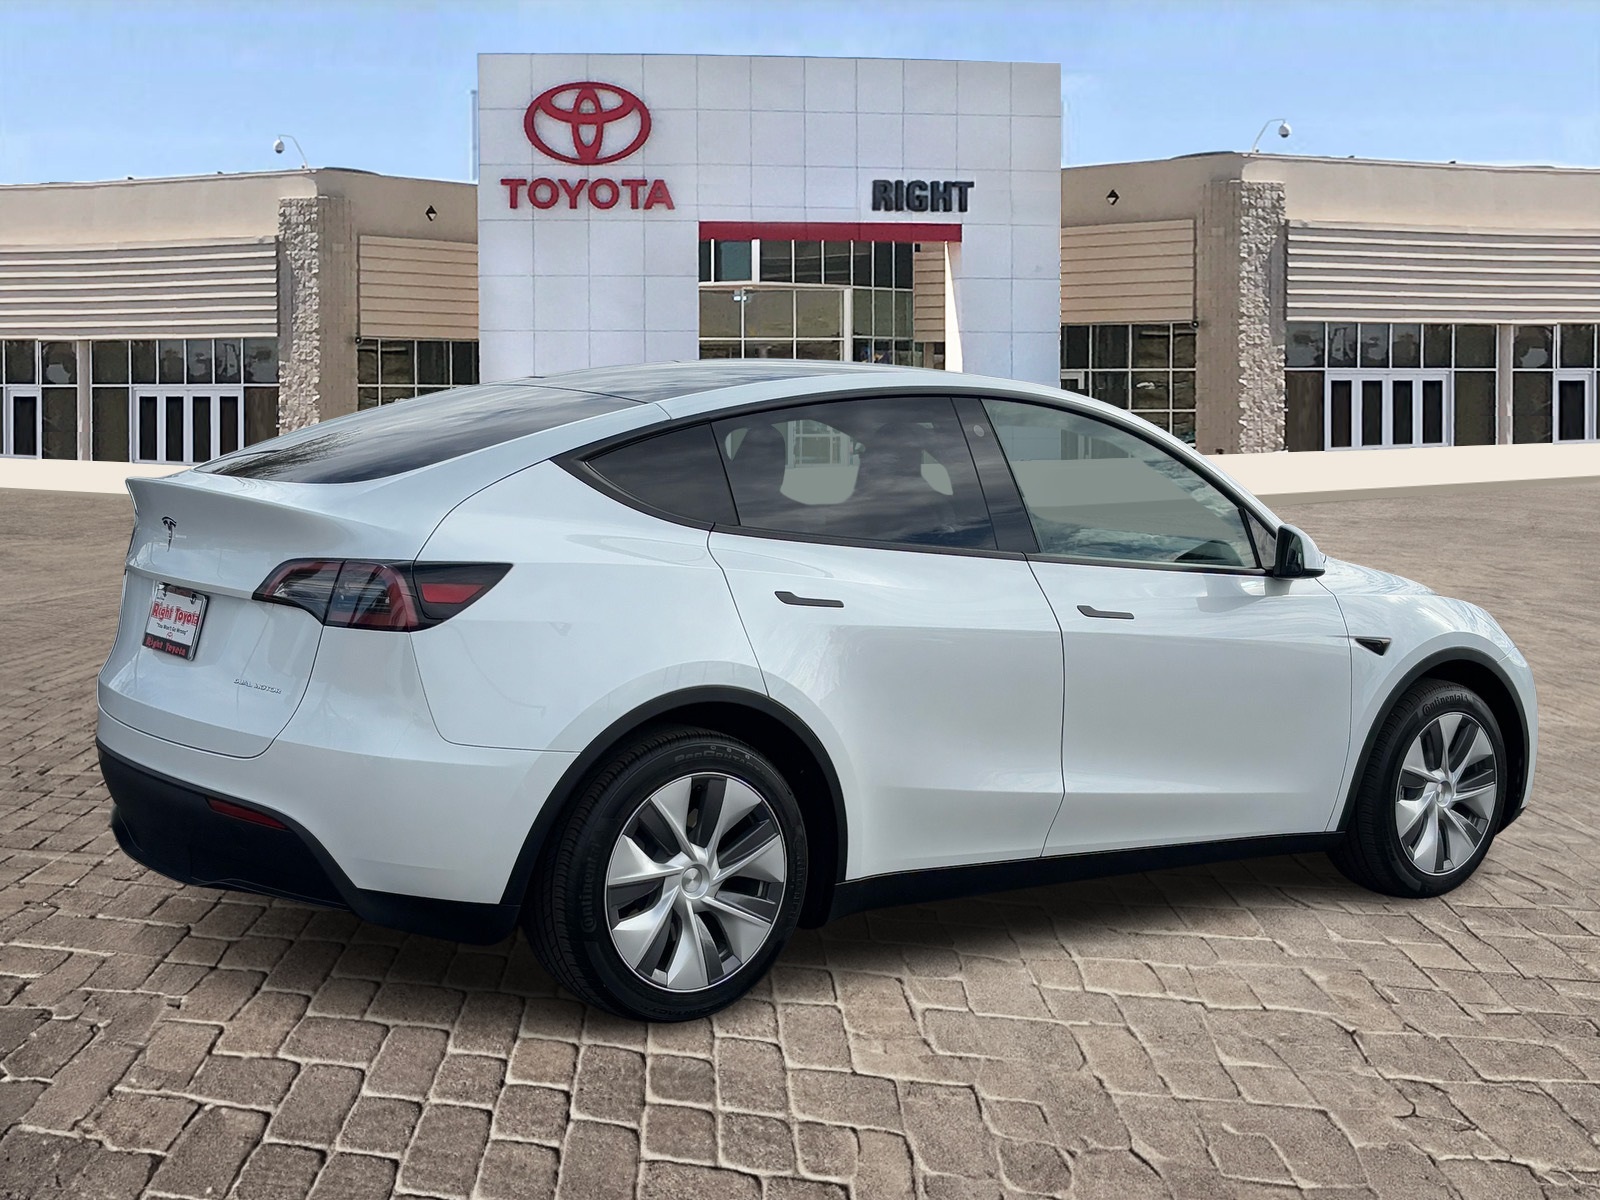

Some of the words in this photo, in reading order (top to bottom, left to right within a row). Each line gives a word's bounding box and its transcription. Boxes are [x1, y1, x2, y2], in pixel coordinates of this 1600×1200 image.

[500, 178, 675, 210] TOYOTA
[871, 179, 975, 213] RIGHT
[152, 602, 174, 621] Right
[174, 607, 199, 626] Toyota
[145, 636, 163, 649] Right
[165, 642, 186, 656] Toyota
[233, 678, 253, 688] DUAL
[253, 683, 282, 695] MOTOR
[1422, 693, 1465, 716] Continental
